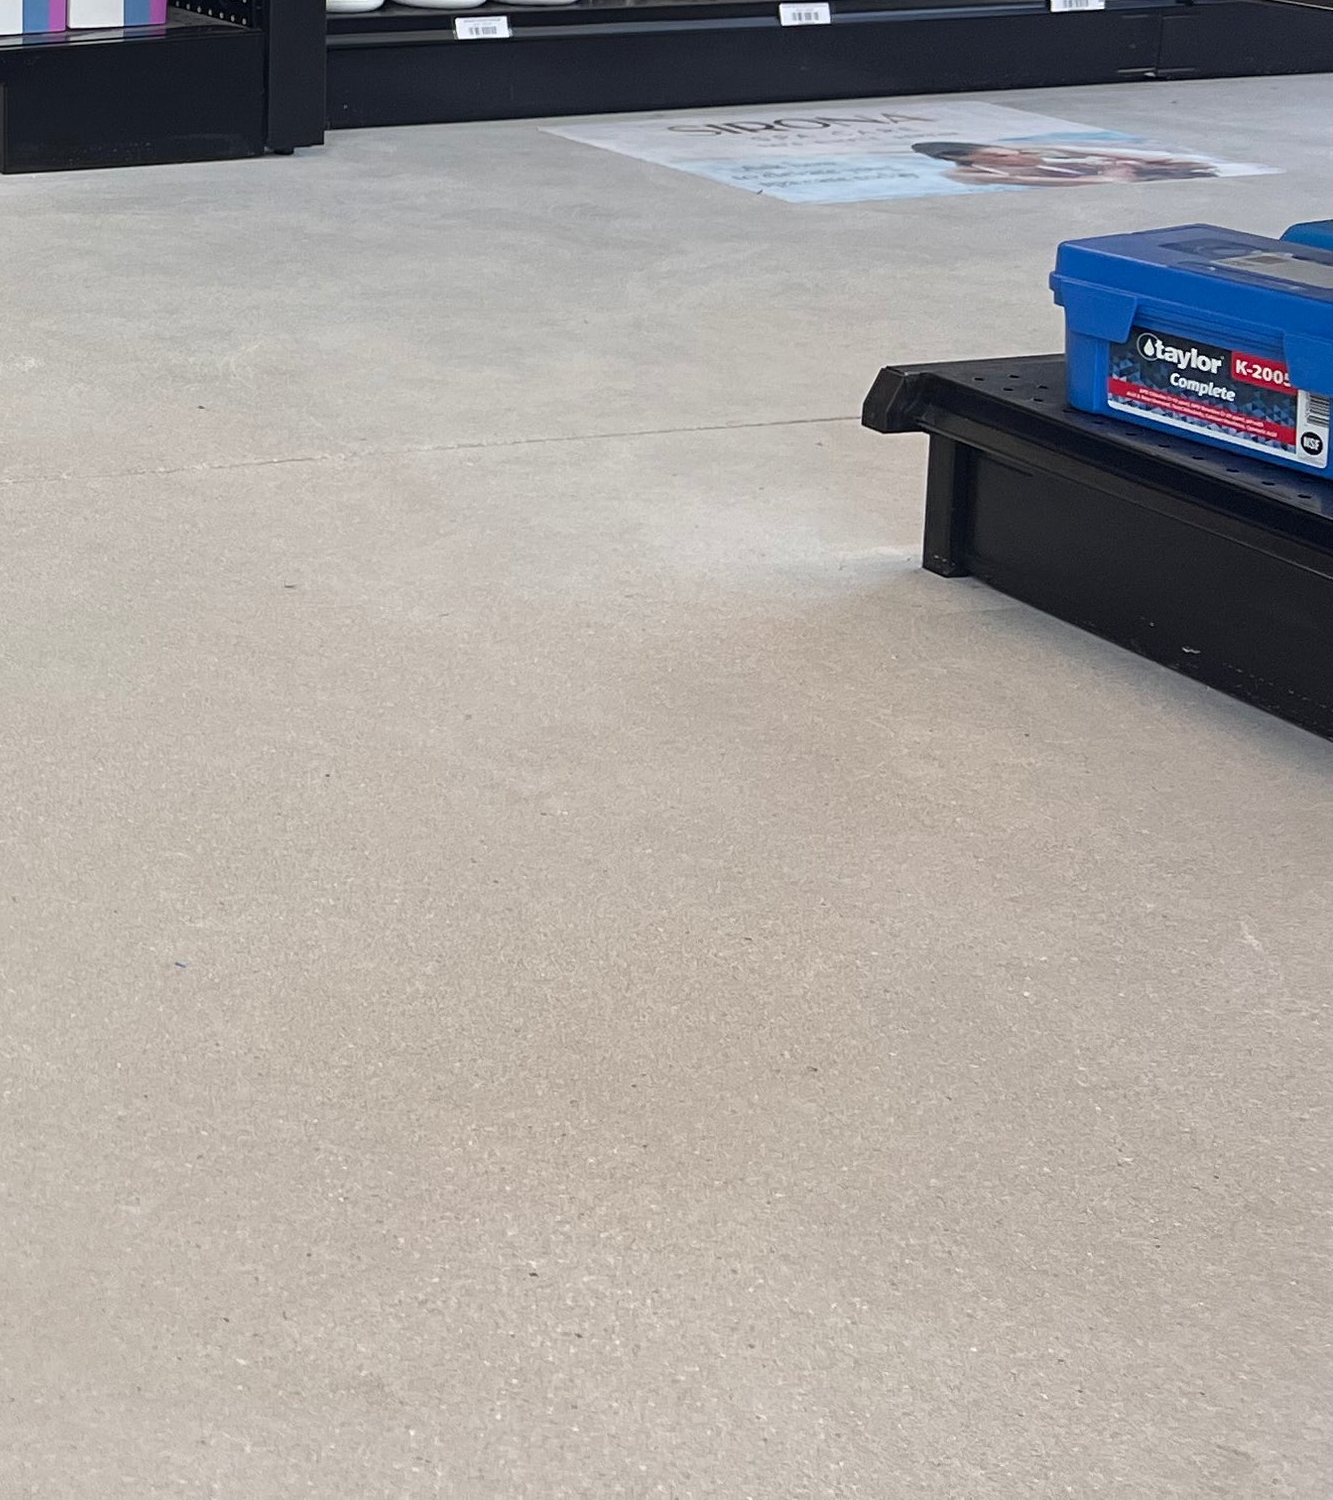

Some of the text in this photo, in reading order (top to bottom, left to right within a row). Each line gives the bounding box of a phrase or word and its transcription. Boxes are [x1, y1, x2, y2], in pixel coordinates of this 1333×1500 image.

[667, 112, 937, 137] SIRONA
[1153, 338, 1223, 375] taylor
[1169, 372, 1237, 402] Complete
[1302, 436, 1321, 452] NSF
